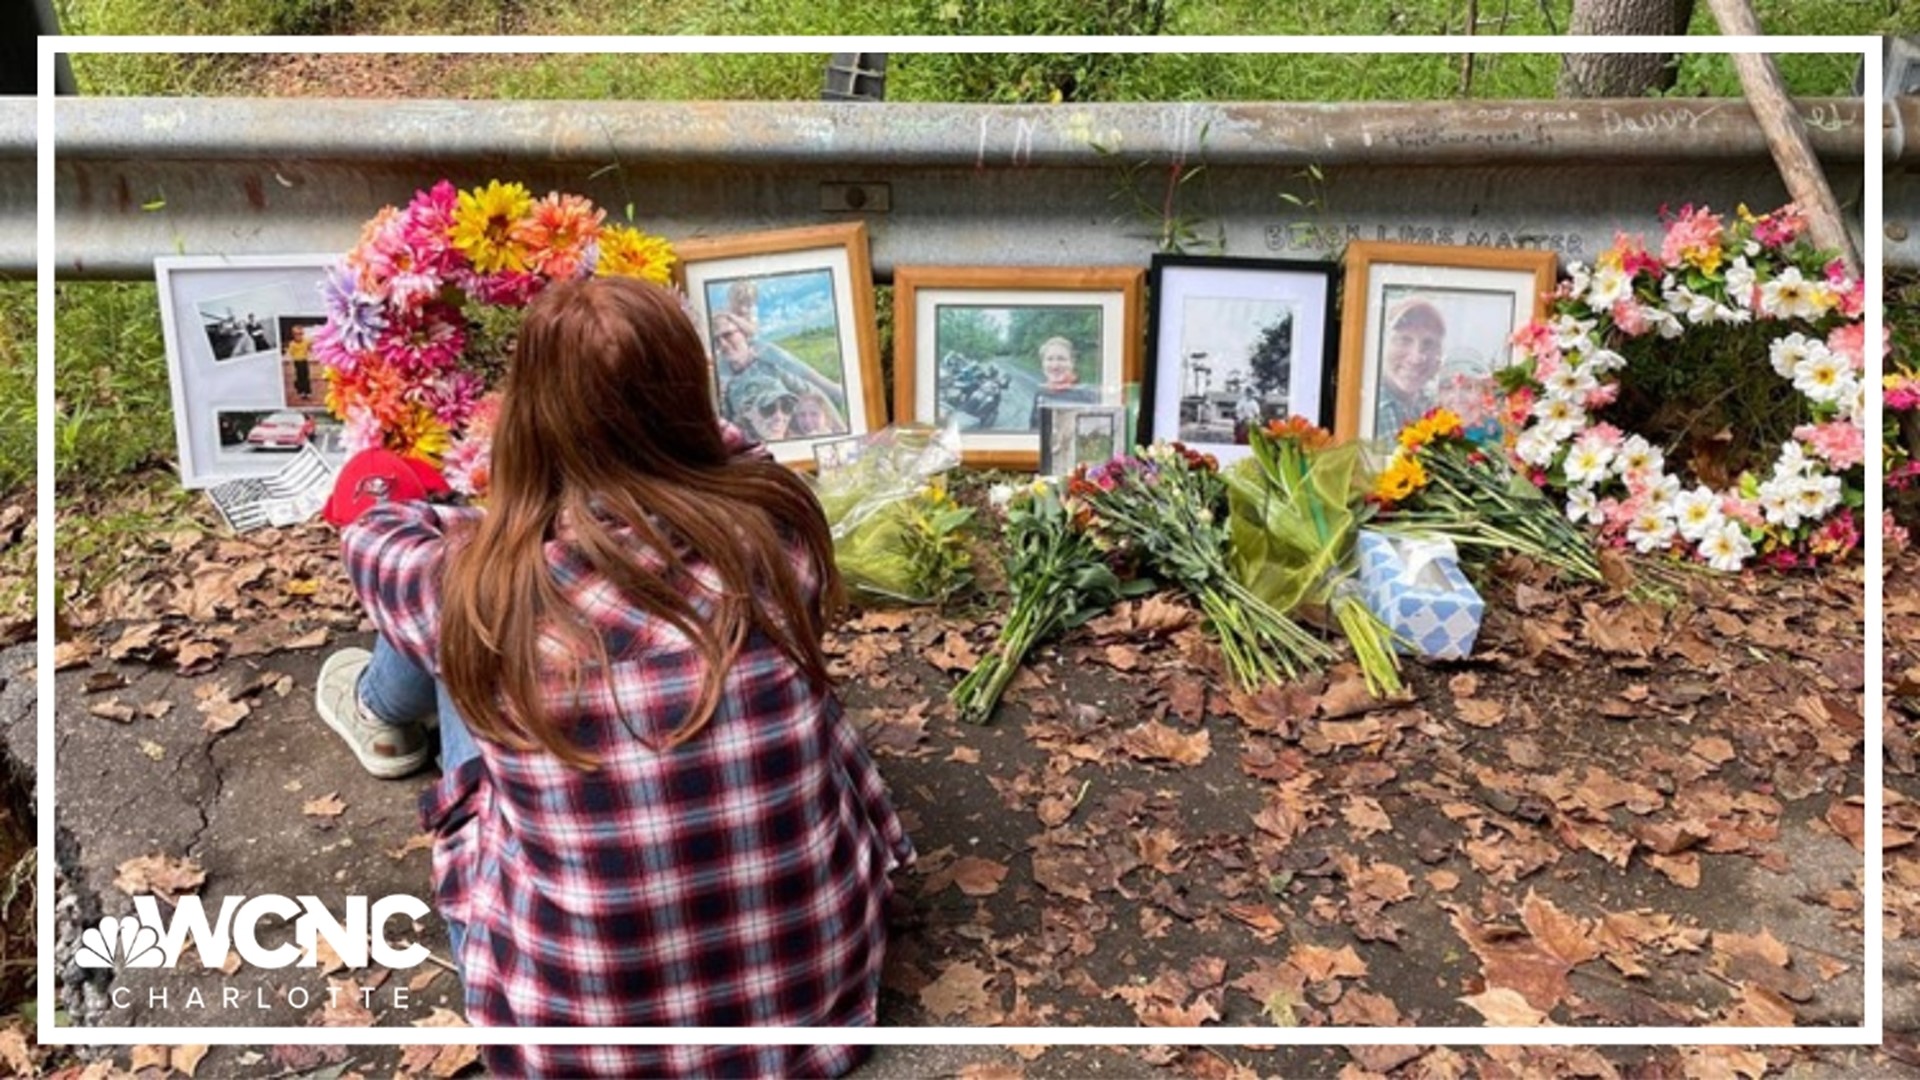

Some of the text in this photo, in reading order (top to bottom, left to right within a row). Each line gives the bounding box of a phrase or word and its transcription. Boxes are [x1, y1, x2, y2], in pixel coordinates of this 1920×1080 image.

[1264, 223, 1585, 254] BLACK LIVES MATTER
